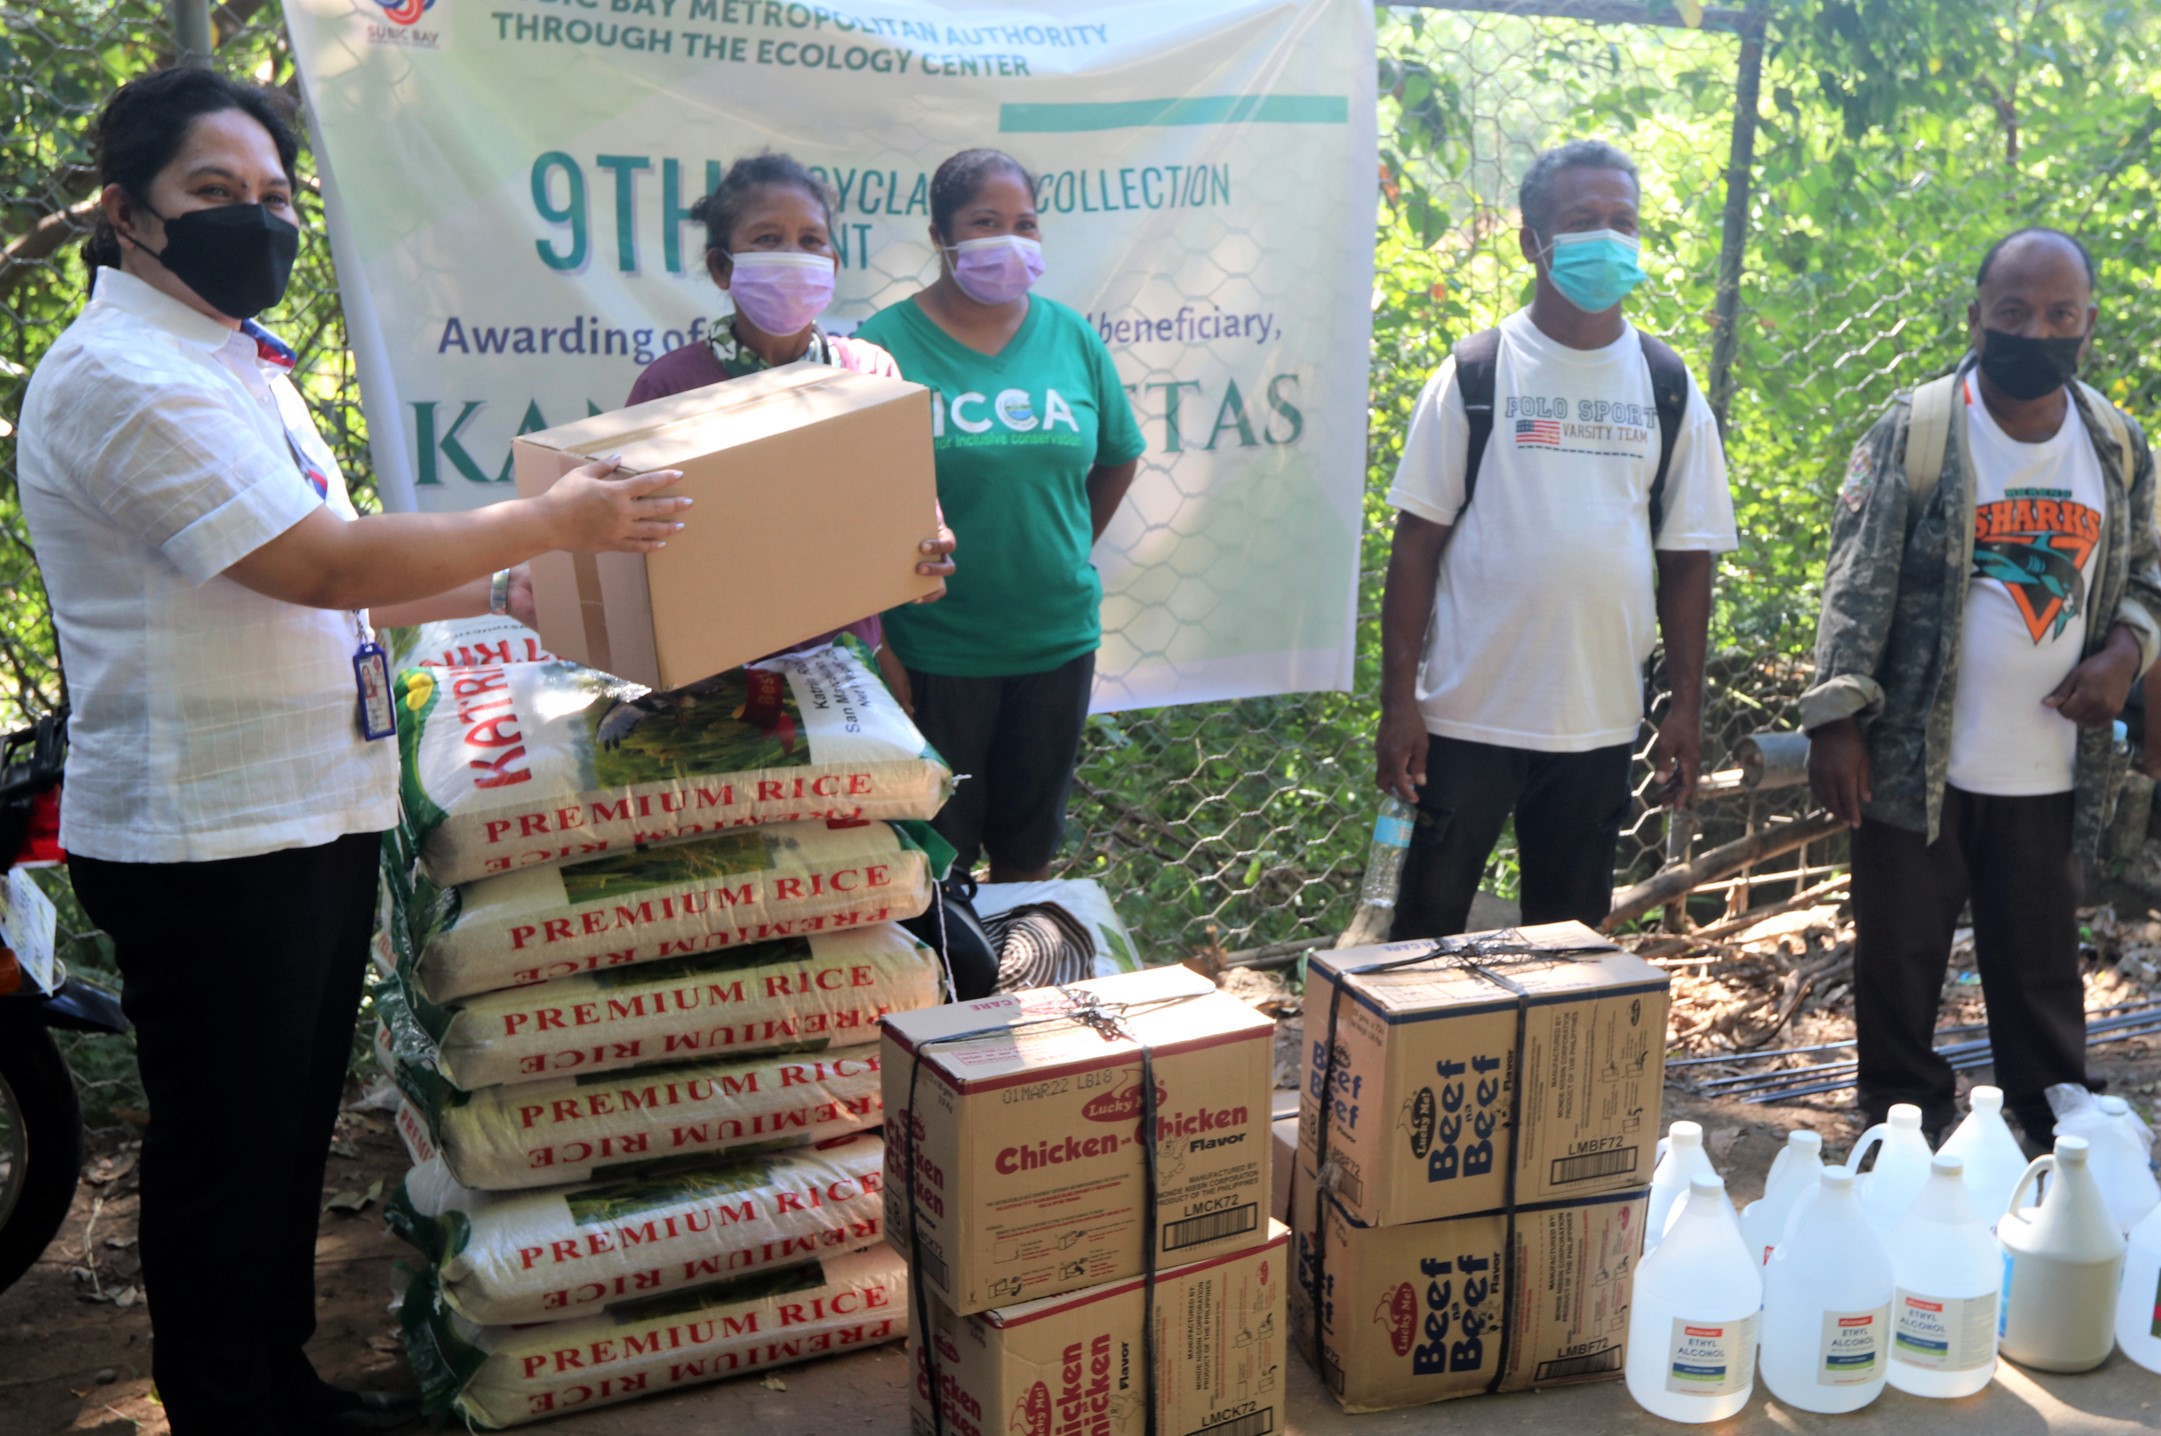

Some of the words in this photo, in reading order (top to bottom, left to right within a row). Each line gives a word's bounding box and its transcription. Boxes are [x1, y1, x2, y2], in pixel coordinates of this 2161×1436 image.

[368, 25, 407, 41] SUBIC
[411, 29, 440, 45] BAY
[688, 0, 939, 44] METROPOLITAN
[946, 23, 1109, 48] AUTHORITY
[491, 12, 673, 53] THROUGH
[682, 32, 747, 62] THE
[757, 39, 913, 73] ECOLOGY
[920, 52, 1031, 77] CENTER
[1034, 163, 1230, 215] COLLECTION
[530, 150, 724, 275] 9TH
[438, 316, 655, 366] Awarding
[662, 317, 708, 351] of
[1099, 306, 1282, 345] beneficiary,
[1505, 396, 1568, 419] POLO
[1578, 399, 1659, 429] SPORT
[955, 433, 1007, 447] inclusive
[1010, 434, 1083, 447] conservation
[1562, 423, 1612, 441] VARSITY
[1617, 427, 1648, 444] TEAM
[1975, 497, 2102, 542] SHARKS
[843, 707, 861, 734] San
[484, 784, 734, 845] PREMIUM
[757, 773, 873, 801] RICE
[508, 883, 754, 951] PREMIUM
[775, 864, 892, 901] RICE
[658, 906, 890, 958] PREMIUM
[513, 948, 635, 985] RICE
[503, 974, 744, 1038] PREMIUM
[765, 964, 875, 1001] RICE
[1561, 1011, 1571, 1065] CORPORATION
[1570, 1011, 1579, 1055] PHILIPPINES
[520, 1038, 642, 1075] RICE
[1503, 1049, 1515, 1093] Flavor
[1551, 1027, 1561, 1088] MANUFACTURED
[1568, 1056, 1576, 1071] THE
[1002, 1078, 1069, 1105] 01MAR22
[1076, 1069, 1113, 1091] LB18
[1559, 1066, 1567, 1091] NISSIN
[1568, 1073, 1575, 1083] OF
[518, 1071, 760, 1130] PREMIUM
[1088, 1100, 1132, 1118] Lucky
[1418, 1091, 1434, 1114] Me!
[1462, 1054, 1502, 1178] Beef
[1464, 1103, 1473, 1124] na
[1557, 1092, 1566, 1119] MONDE
[1565, 1083, 1574, 1120] PRODUCT
[671, 1095, 882, 1146] REMIUM
[1414, 1113, 1431, 1158] Lucky
[1428, 1059, 1466, 1183] Beef
[529, 1131, 651, 1169] RICE
[995, 1134, 1118, 1175] Chicken
[1189, 1133, 1247, 1153] Flavor
[1568, 1136, 1624, 1155] LMBF72
[1157, 1194, 1189, 1206] RODUCT
[1191, 1191, 1200, 1200] OF
[1202, 1187, 1216, 1197] THE
[1217, 1177, 1259, 1194] PHILIPPINES
[1185, 1182, 1208, 1193] NISSIN
[1209, 1170, 1259, 1186] CORPORATION
[1189, 1164, 1246, 1183] MANUFACTURED
[518, 1199, 757, 1271] PREMIUM
[776, 1171, 884, 1215] RICE
[1184, 1194, 1239, 1217] LMCK72
[685, 1217, 879, 1279] REMIUM
[1556, 1212, 1565, 1269] CORPORATION
[1565, 1212, 1573, 1259] PHILIPPINES
[1490, 1251, 1501, 1294] Flavor
[1548, 1228, 1557, 1290] MANUFACTURED
[544, 1269, 663, 1311] RICE
[1399, 1286, 1412, 1311] Me!
[1564, 1276, 1571, 1287] OF
[1196, 1281, 1205, 1336] CORPORATION
[1204, 1279, 1212, 1325] PHILIPPINES
[1412, 1257, 1453, 1376] Beef
[1450, 1253, 1489, 1373] Beef
[1452, 1301, 1461, 1321] na
[1555, 1296, 1563, 1322] MONDE
[1562, 1288, 1570, 1323] PRODUCT
[1908, 1309, 1938, 1322] ETHYL
[522, 1310, 761, 1380] PREMIUM
[780, 1285, 890, 1326] RICE
[1187, 1299, 1196, 1360] MANUFACTURED
[1397, 1311, 1411, 1352] Lucky
[1688, 1338, 1718, 1348] ETHYL
[1831, 1336, 1875, 1347] ALCOHOL
[1842, 1327, 1868, 1337] ETHYL
[1900, 1316, 1947, 1333] ALCOHOL
[669, 1319, 893, 1383] PREMIUM
[1119, 1341, 1130, 1391] Flavor
[1204, 1343, 1210, 1354] OF
[1557, 1337, 1609, 1358] LMBF72
[1677, 1347, 1725, 1358] ALCOHOL
[1195, 1364, 1203, 1391] MONDE
[1203, 1355, 1211, 1391] PRODUCT
[527, 1371, 649, 1415] RICE
[1202, 1401, 1257, 1427] LMCK72
